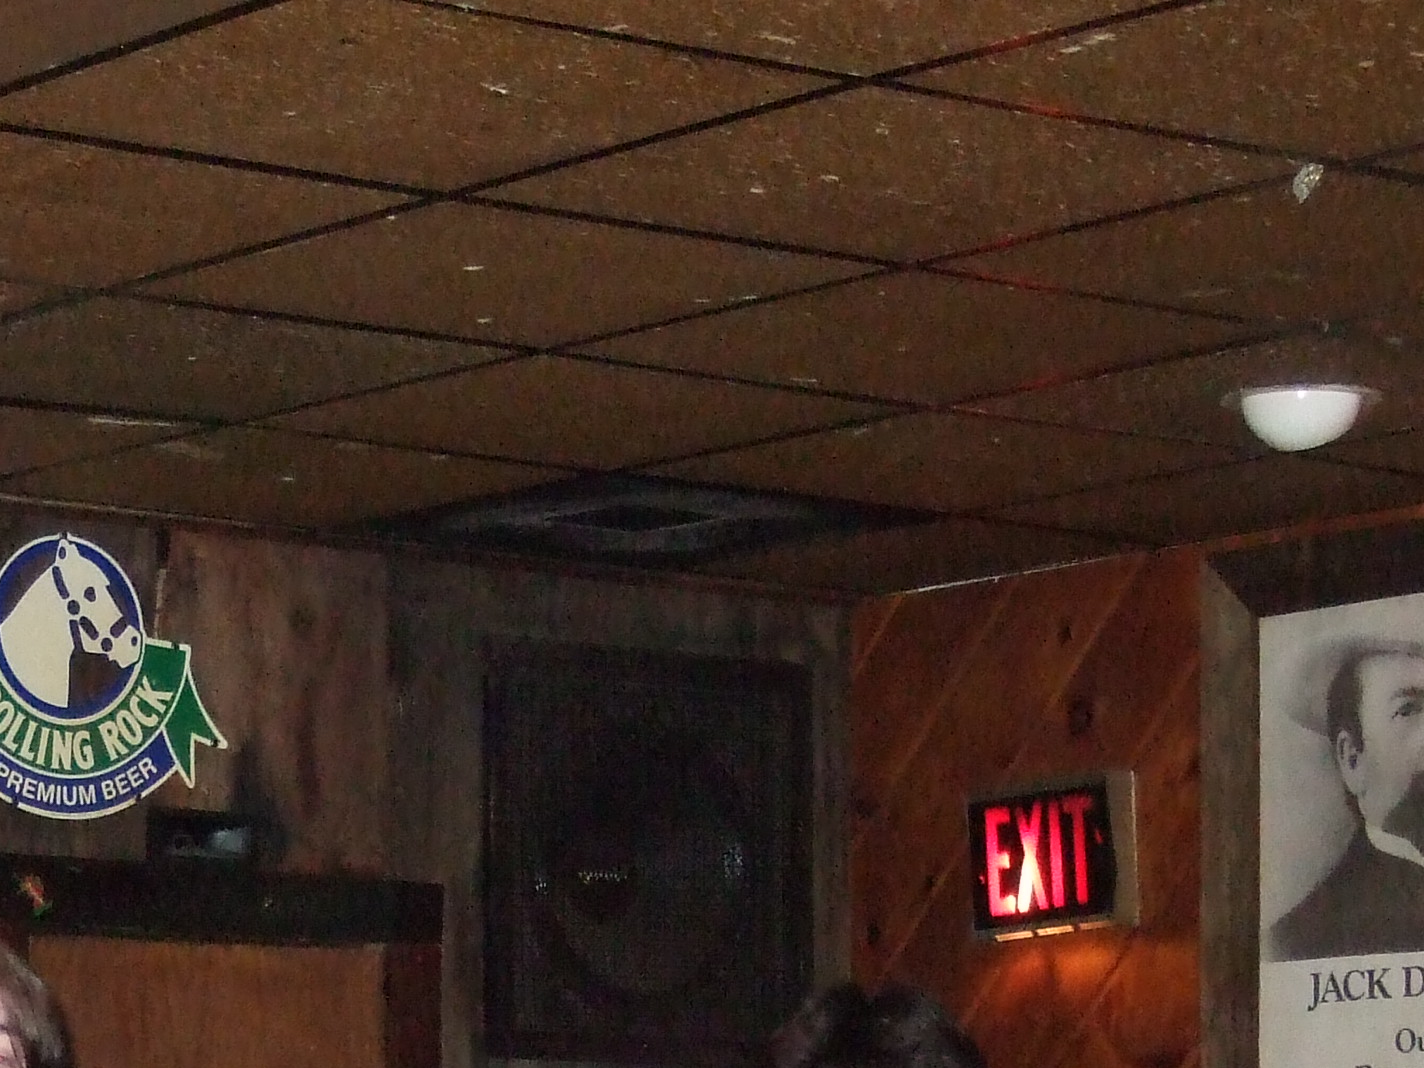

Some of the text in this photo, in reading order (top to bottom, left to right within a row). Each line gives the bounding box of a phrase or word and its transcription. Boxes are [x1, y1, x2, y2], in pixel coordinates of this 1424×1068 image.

[99, 675, 174, 761] ROCK
[102, 756, 159, 800] BEER
[984, 793, 1094, 917] EXIT
[1307, 967, 1393, 1012] JACK
